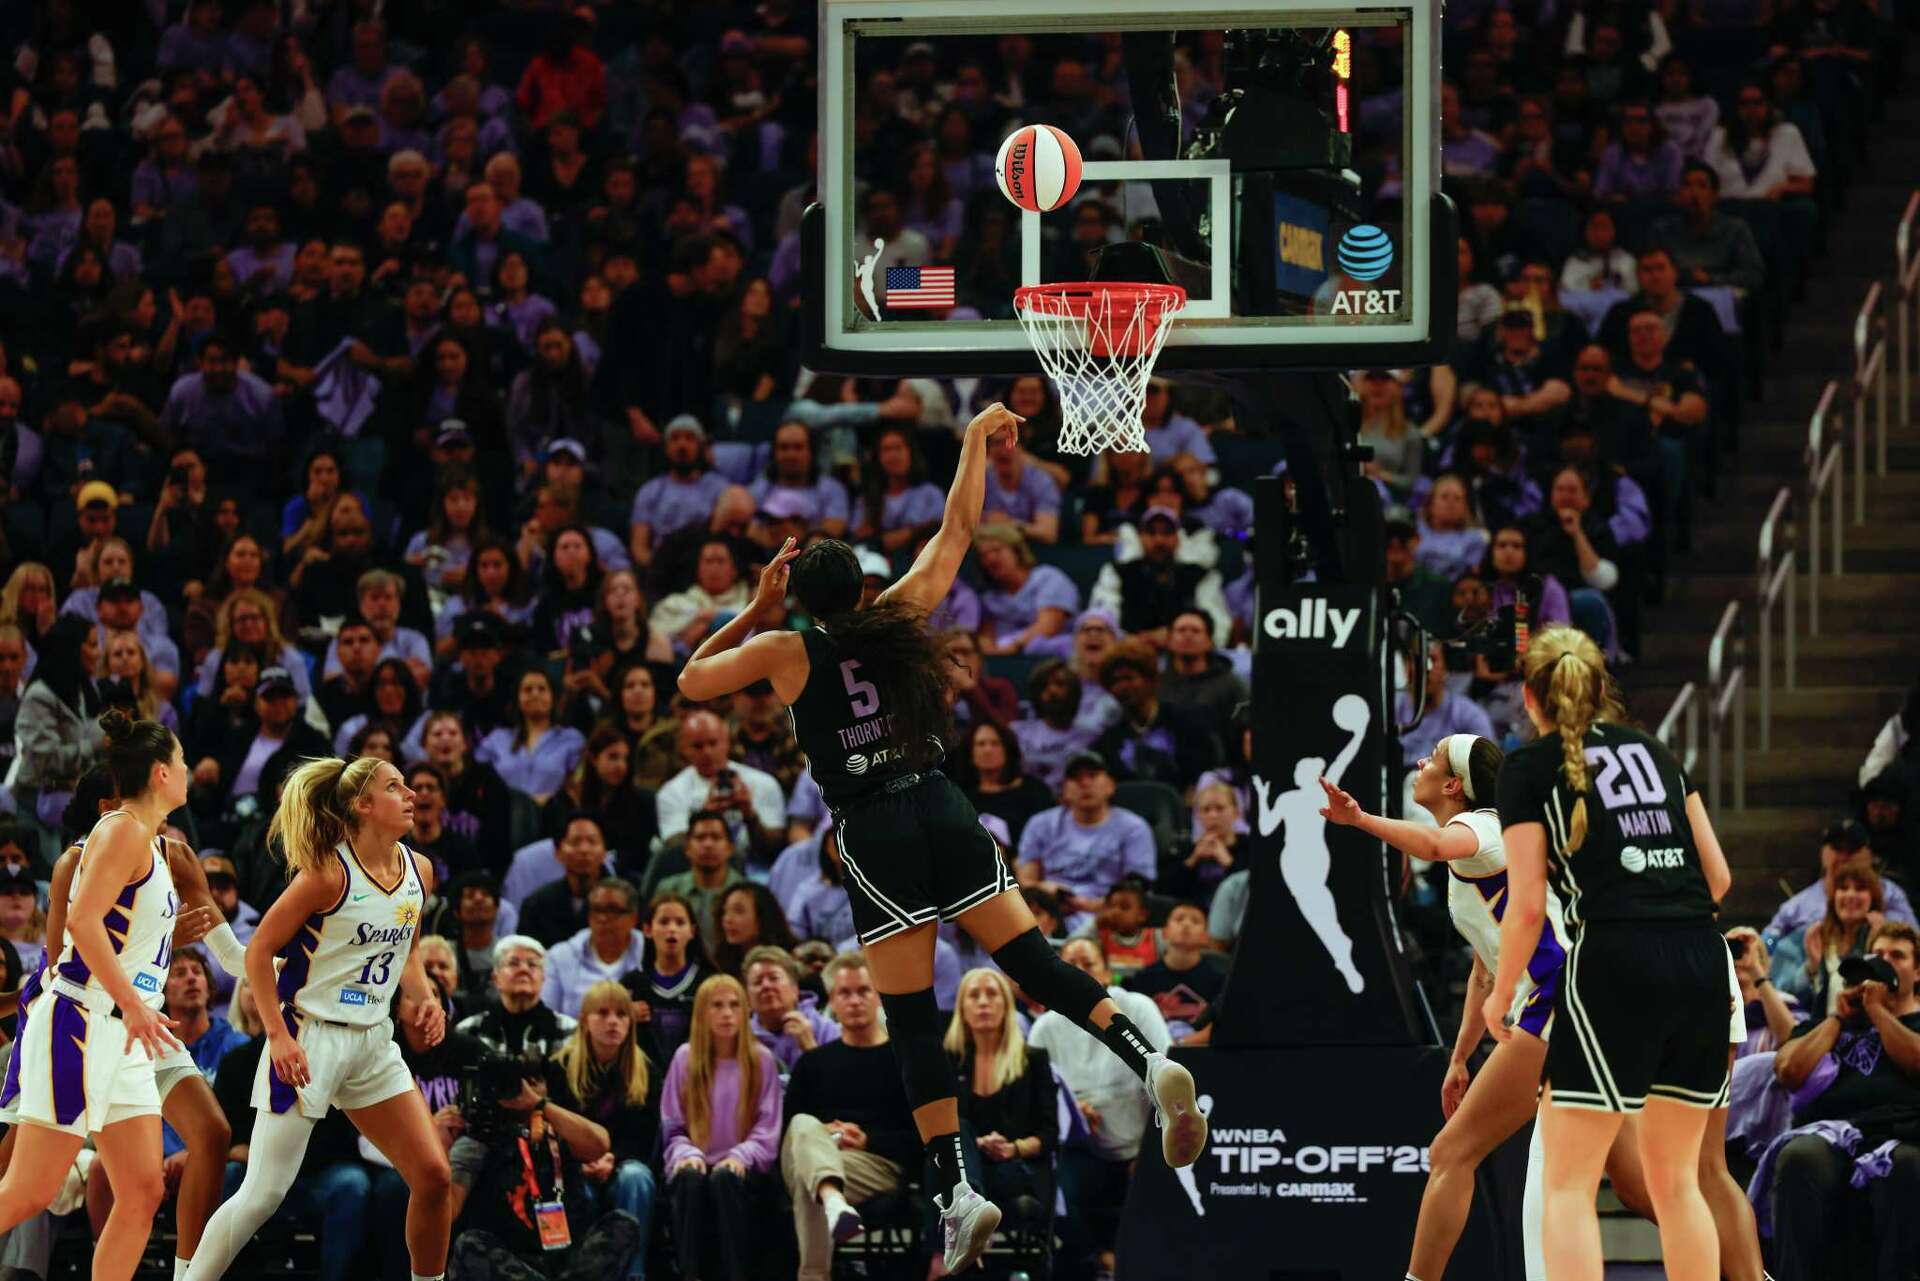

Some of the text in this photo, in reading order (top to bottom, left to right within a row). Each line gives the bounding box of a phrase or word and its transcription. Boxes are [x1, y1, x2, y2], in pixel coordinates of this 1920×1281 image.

[1011, 143, 1028, 198] Wilson
[1330, 289, 1401, 315] AT&T
[1263, 597, 1362, 649] ally
[840, 659, 880, 719] 5
[837, 714, 897, 751] THORN
[1584, 743, 1666, 810] 20
[1616, 808, 1672, 838] MARTIN
[1647, 847, 1685, 869] AT&T
[355, 951, 396, 986] 13
[1211, 1128, 1287, 1144] WNBA
[1210, 1182, 1257, 1196] Presented
[1259, 1182, 1272, 1198] by
